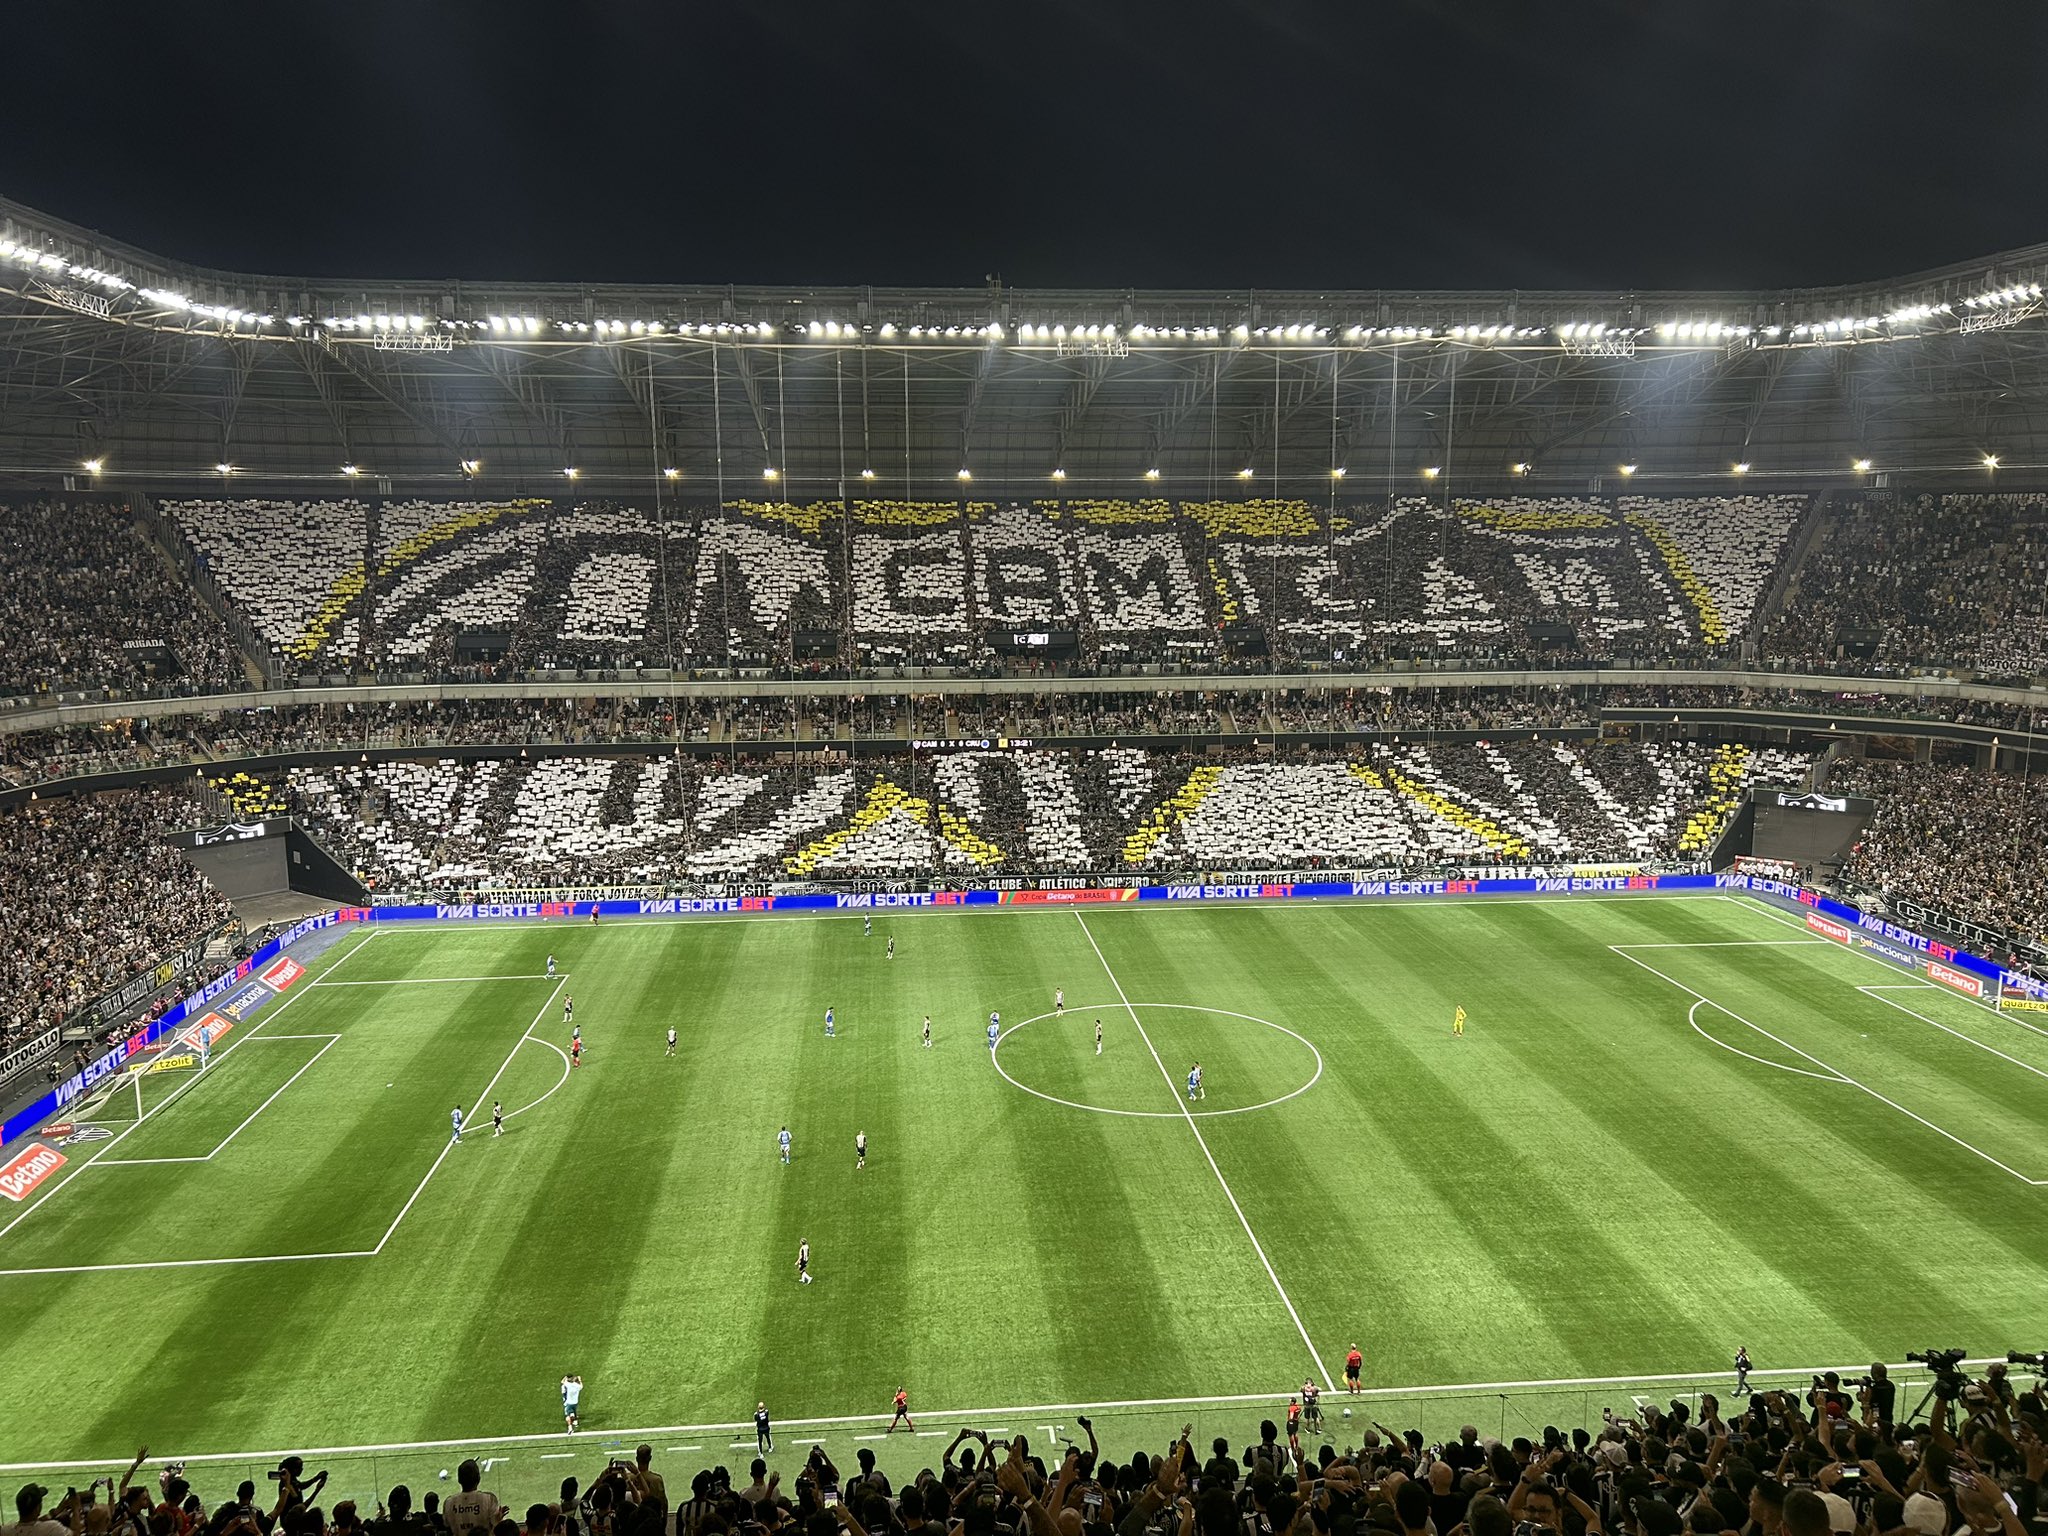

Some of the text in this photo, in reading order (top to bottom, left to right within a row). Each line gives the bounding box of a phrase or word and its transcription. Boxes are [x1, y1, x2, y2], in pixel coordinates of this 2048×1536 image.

[123, 639, 166, 649] BRIGADA
[1227, 874, 1251, 885] GALO
[1256, 874, 1287, 885] FORTE
[1291, 874, 1297, 884] E
[1461, 867, 1549, 880] FURIA
[989, 878, 1022, 890] CLUBE
[1039, 877, 1087, 890] ATLÉTICO
[1536, 879, 1568, 891] VIVA
[1714, 875, 1749, 888] VIVA
[608, 887, 643, 900] JOVEM
[725, 883, 773, 897] DESDE
[1167, 886, 1200, 899] VIVA
[1352, 882, 1386, 895] VIVA
[837, 893, 872, 907] VIVA
[1047, 892, 1075, 900] Betano
[436, 905, 473, 919] VIVA
[640, 900, 675, 913] VIVA
[1809, 916, 1847, 937] SUPERBET
[1858, 912, 1884, 934] VIVA
[279, 926, 296, 950] VIVA
[1860, 935, 1912, 965] betnacional
[267, 960, 300, 986] SUPERBET
[1931, 966, 1977, 992] Betano
[101, 948, 194, 1018] VELHA BRIGADA CAMISA 13
[183, 988, 206, 1016] VIVA
[222, 984, 269, 1017] betnacional
[2003, 1001, 2048, 1010] quartzo
[55, 1072, 84, 1107] VIVA
[41, 1125, 71, 1134] Betano
[0, 1151, 58, 1195] Betano
[458, 1504, 480, 1516] bmg
